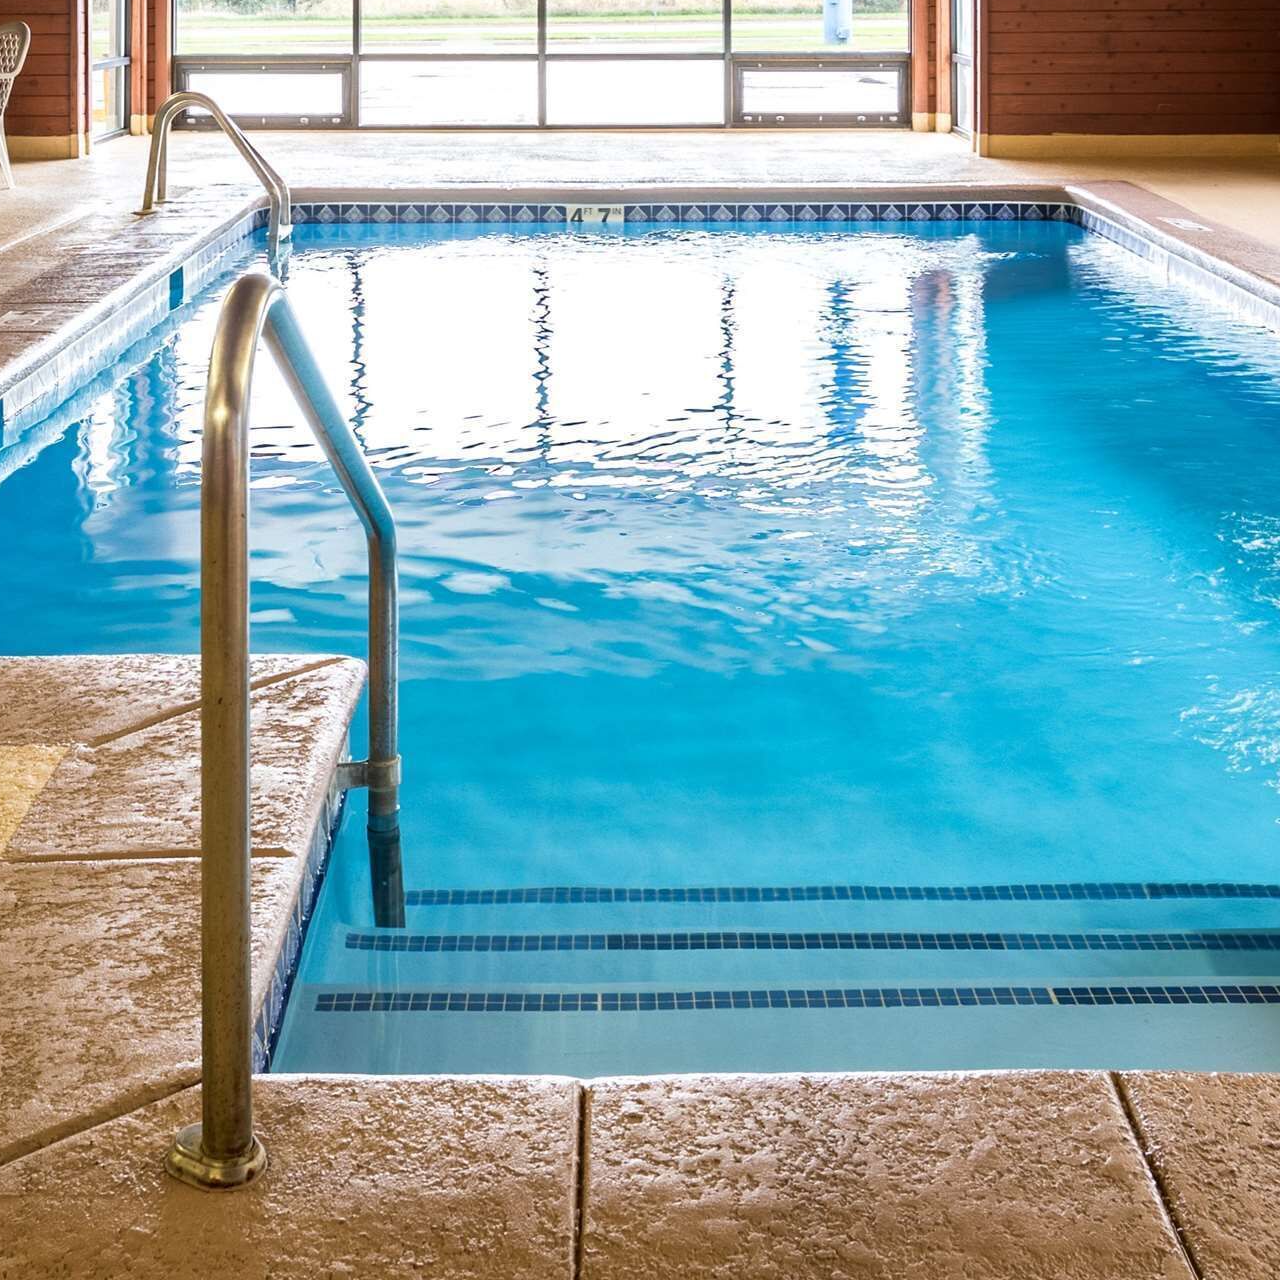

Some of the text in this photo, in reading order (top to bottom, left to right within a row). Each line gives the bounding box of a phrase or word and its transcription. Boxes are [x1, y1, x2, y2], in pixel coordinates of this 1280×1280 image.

[570, 208, 584, 223] 4
[584, 208, 593, 216] FT
[598, 208, 611, 223] 7
